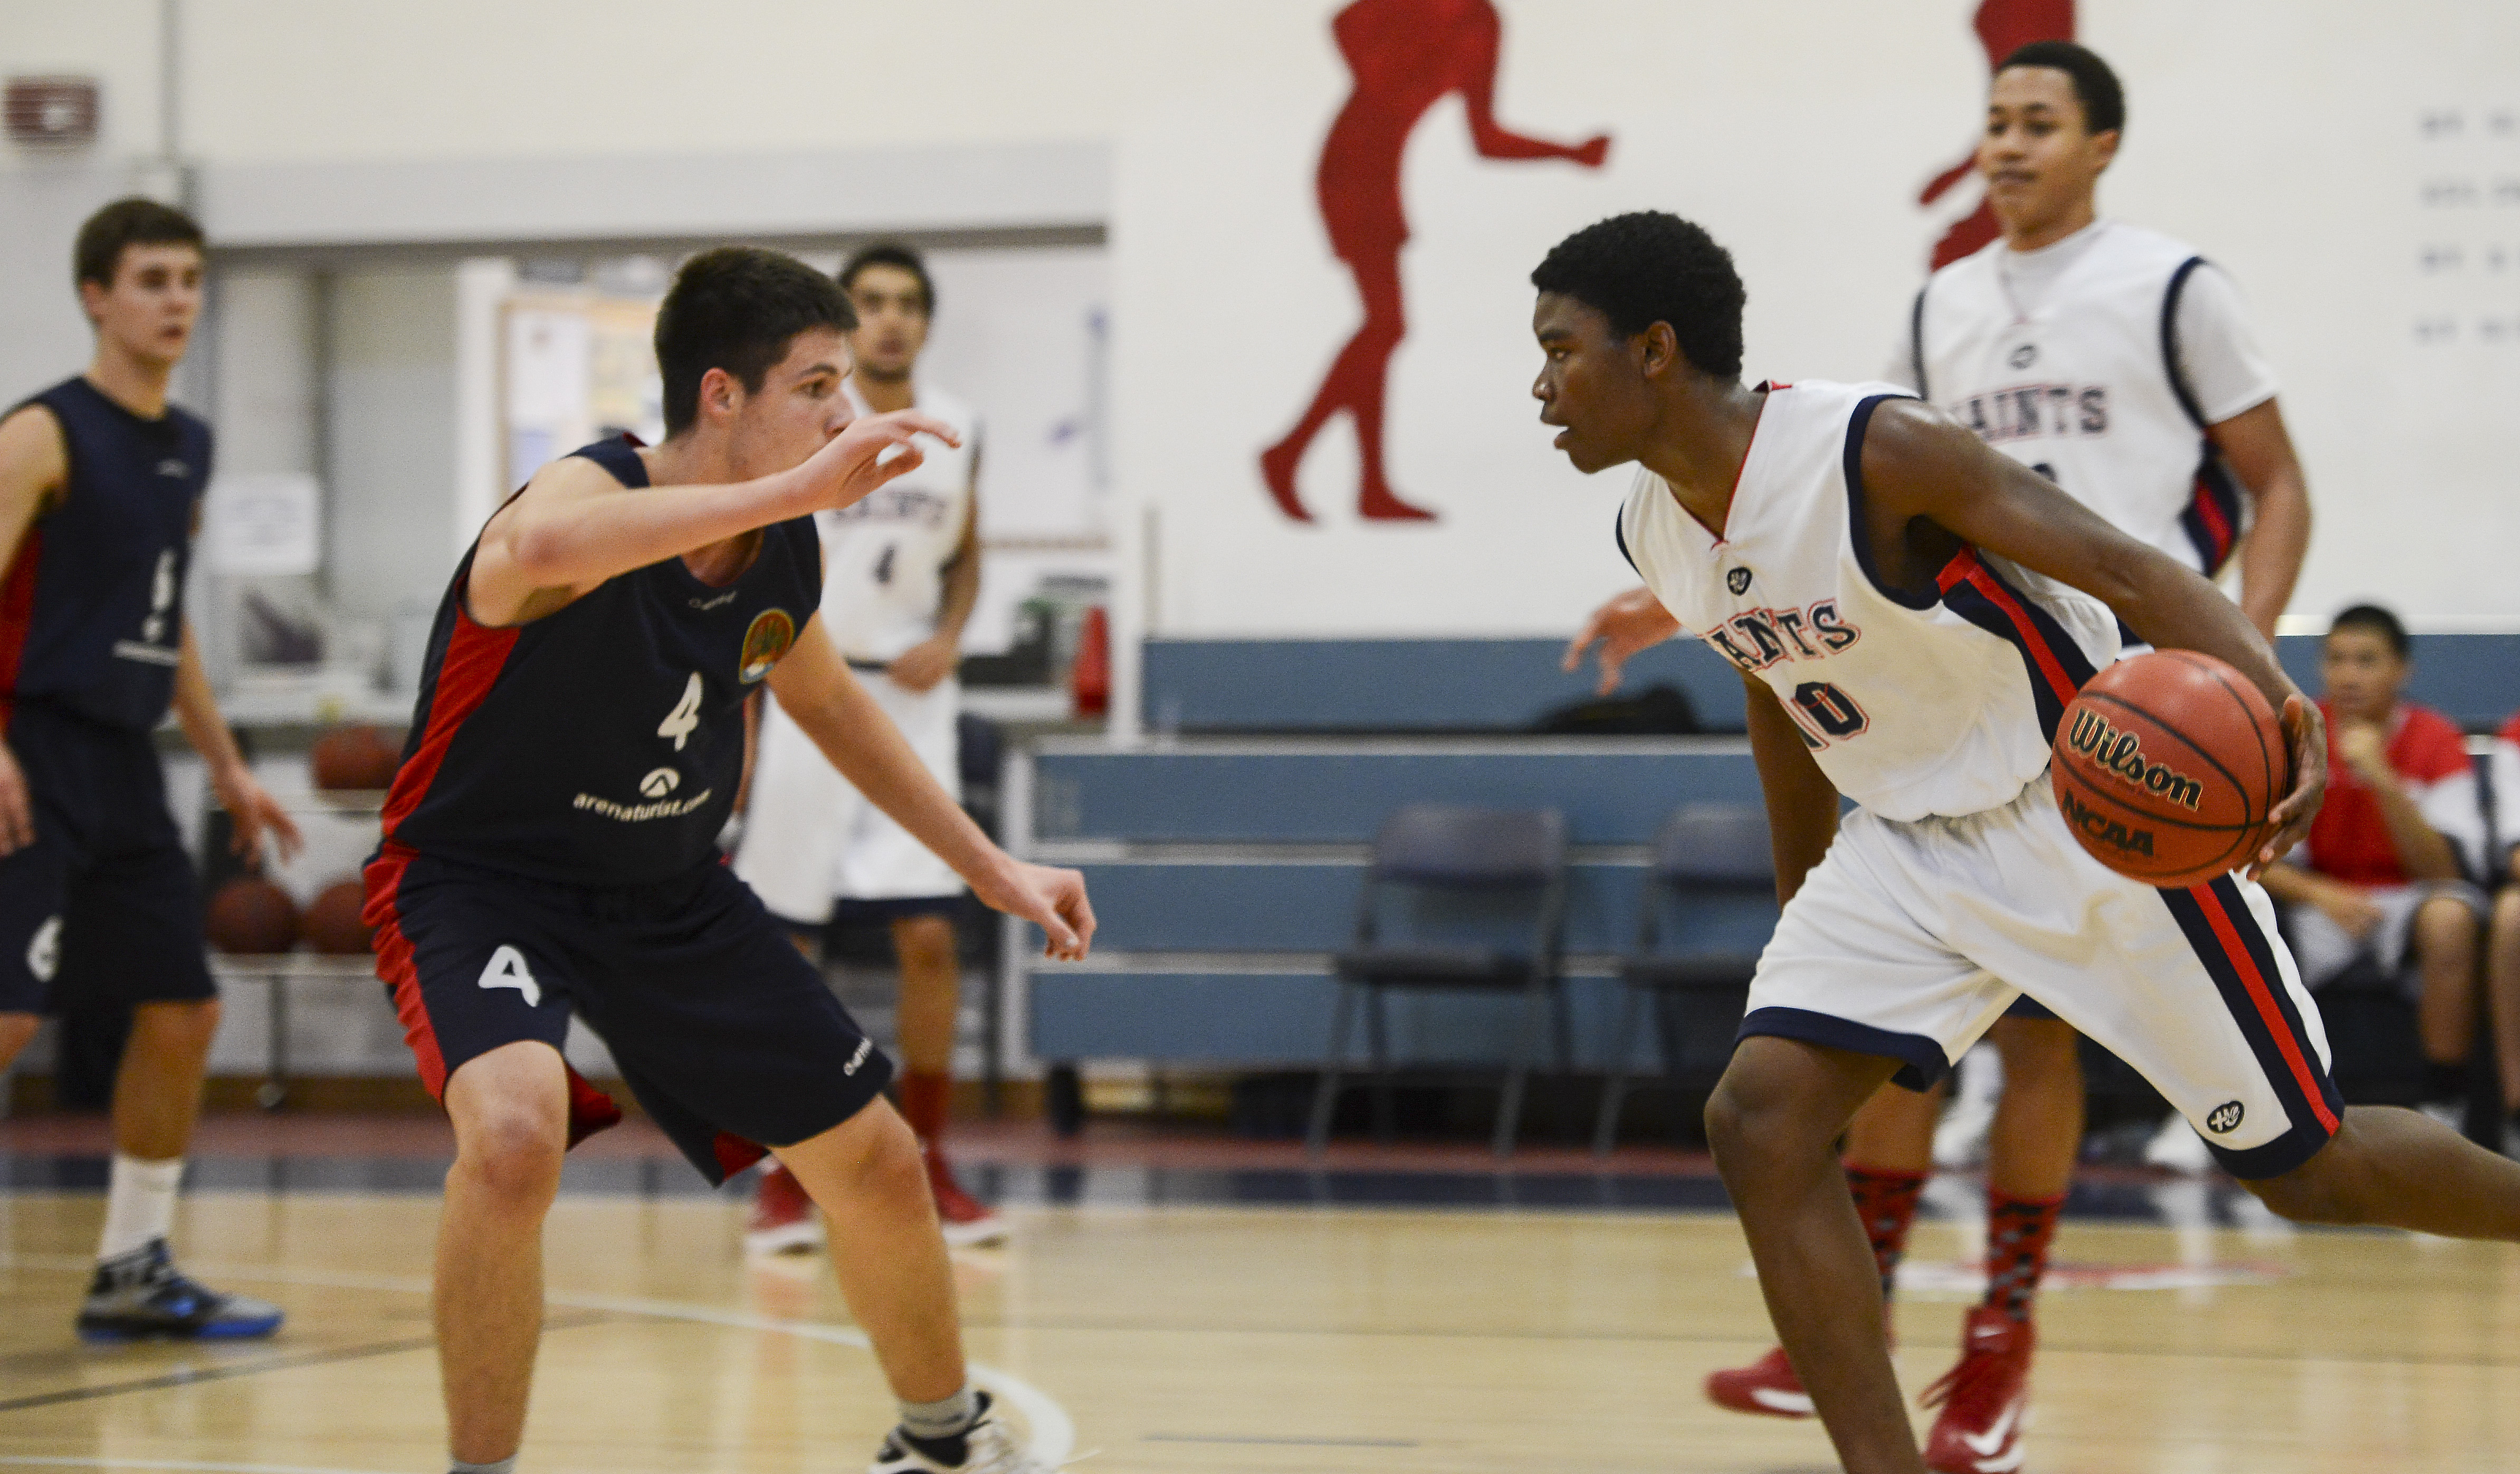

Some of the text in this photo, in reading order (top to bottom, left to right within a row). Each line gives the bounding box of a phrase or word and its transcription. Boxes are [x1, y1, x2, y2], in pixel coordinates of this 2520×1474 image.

[1948, 384, 2109, 446] AINTS
[657, 671, 703, 752] 4
[2068, 707, 2203, 813] Wilson
[2061, 788, 2154, 857] NCAA
[478, 944, 541, 1007] 4
